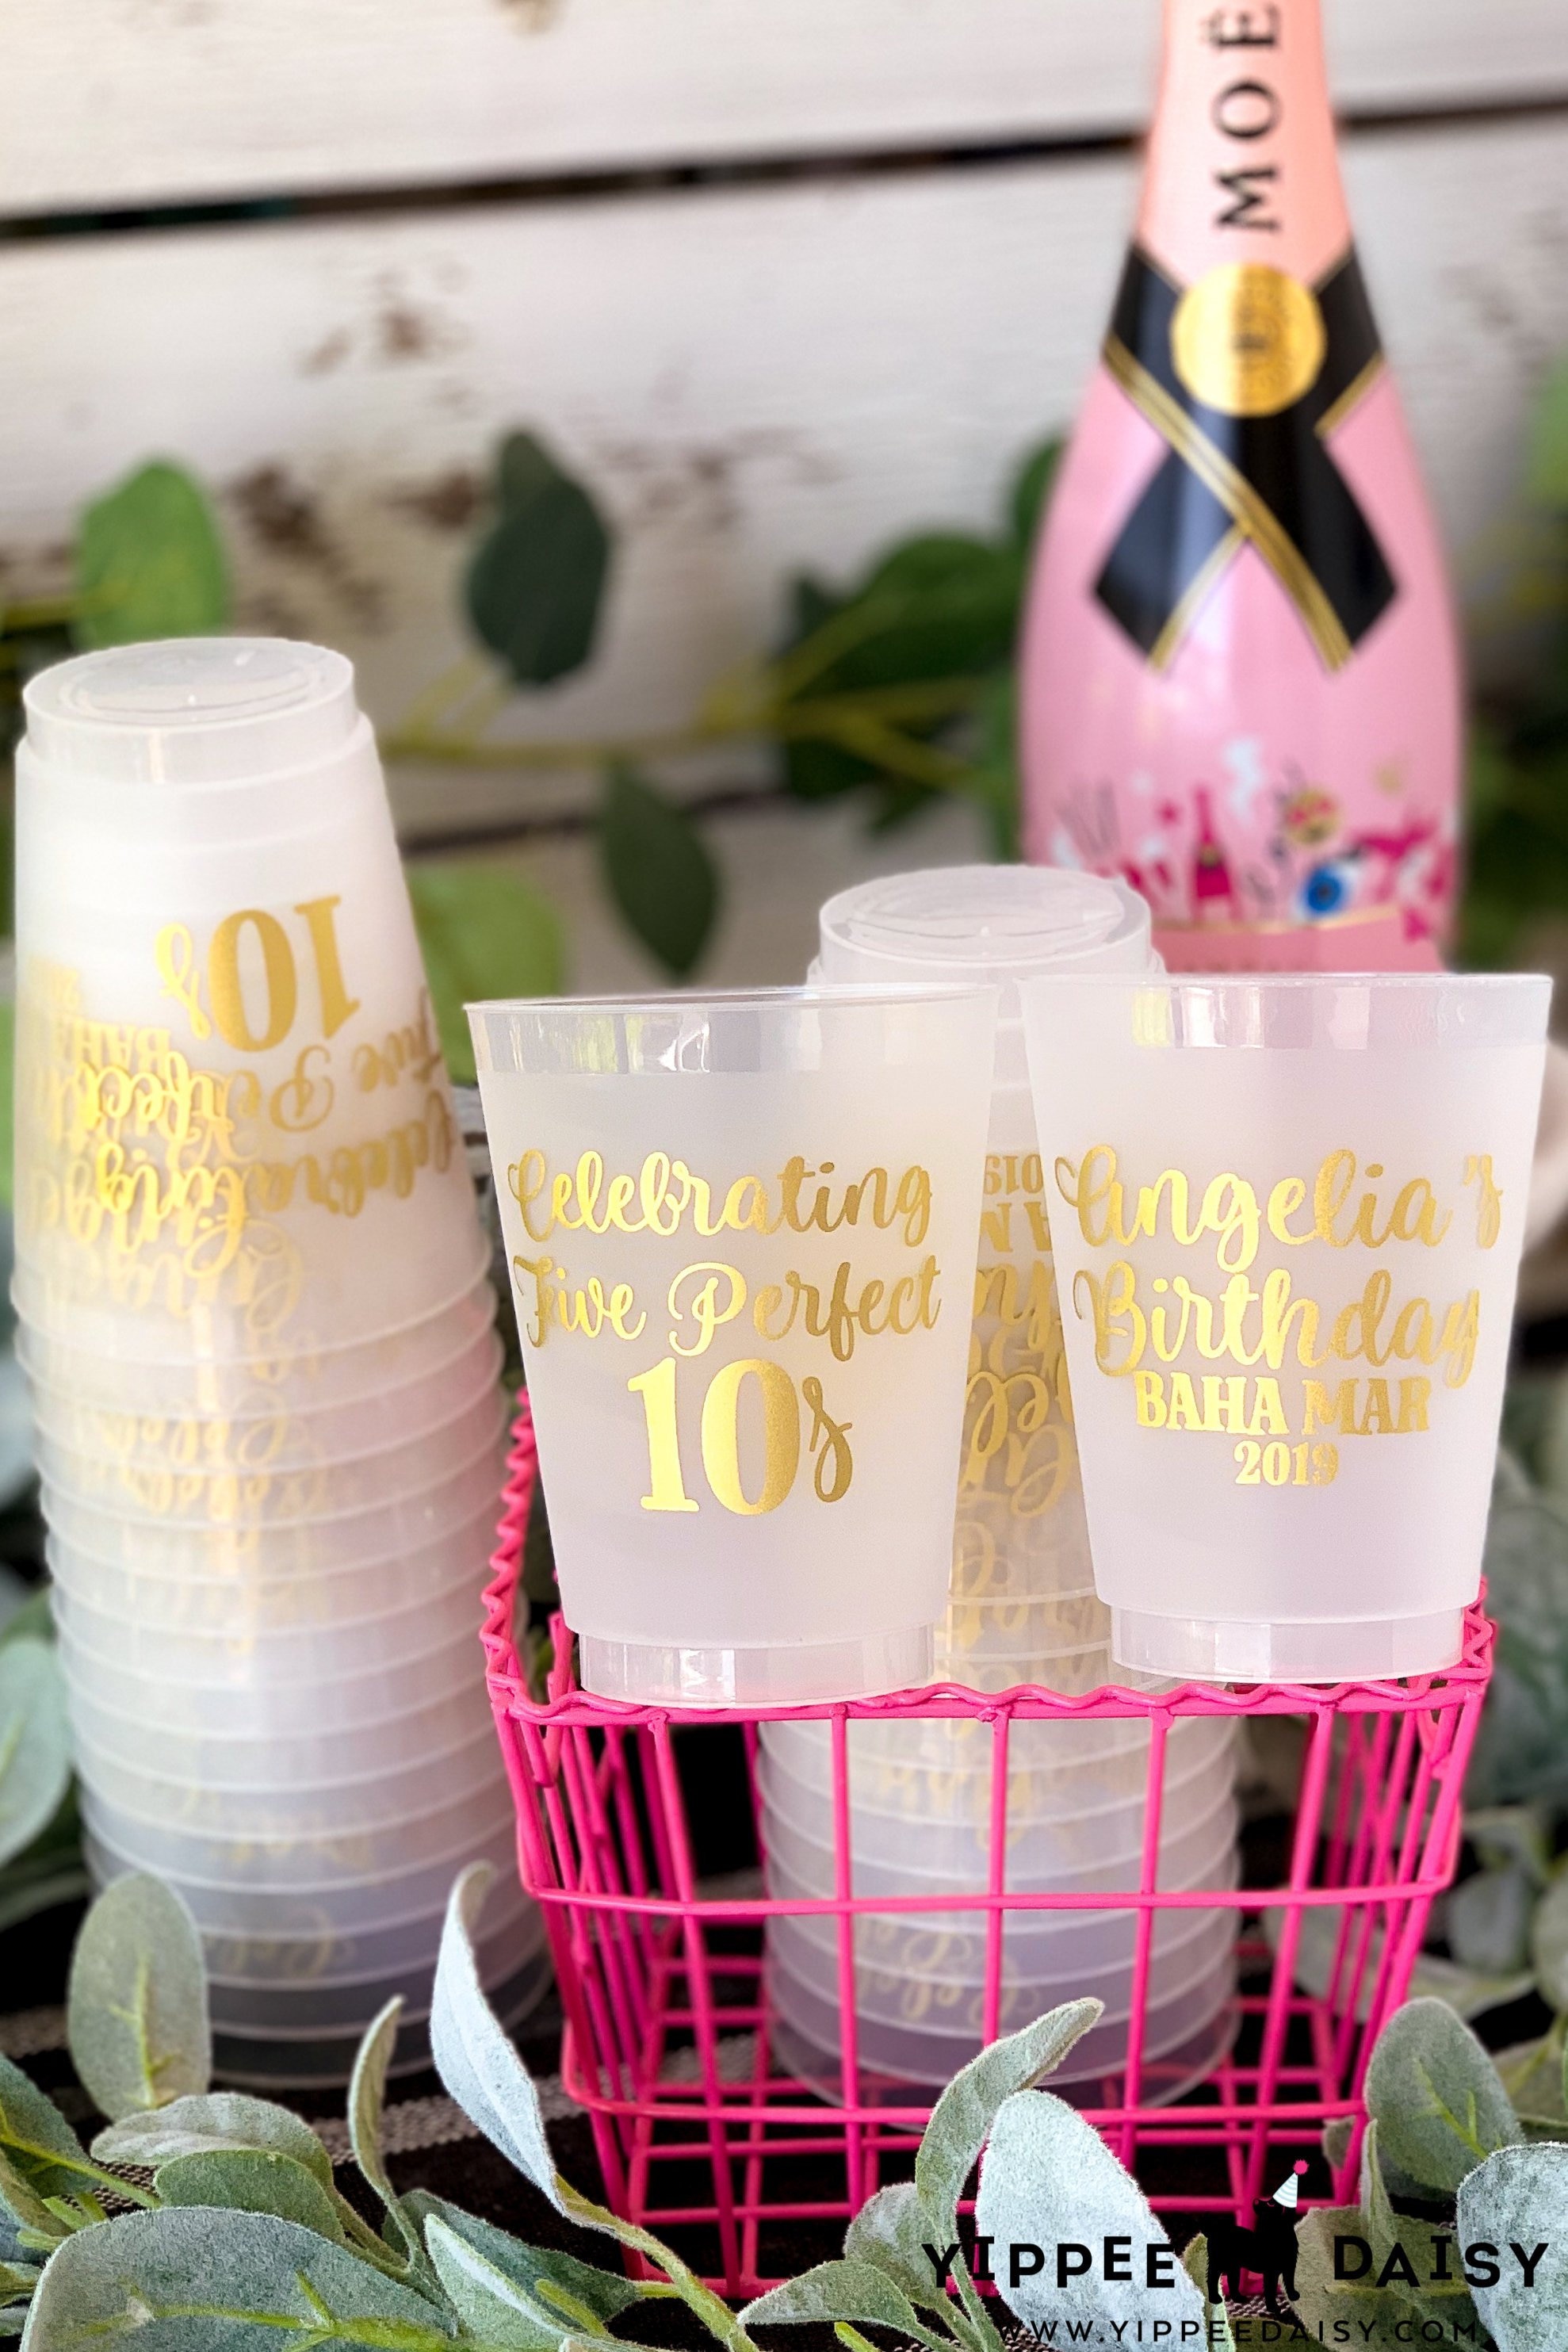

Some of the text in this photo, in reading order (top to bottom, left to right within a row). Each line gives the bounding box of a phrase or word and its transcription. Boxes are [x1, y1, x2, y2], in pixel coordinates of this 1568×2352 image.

[507, 1149, 934, 1248] Celebrating
[984, 1154, 1043, 1196] 019
[1054, 1144, 1504, 1273] Angelia's
[513, 1255, 648, 1348] Five
[667, 1254, 943, 1362] Perfect
[1073, 1260, 1482, 1389] Birthday
[626, 1356, 854, 1516] 10s
[1133, 1370, 1432, 1436] BAHA MAR
[1233, 1440, 1340, 1486] 2019
